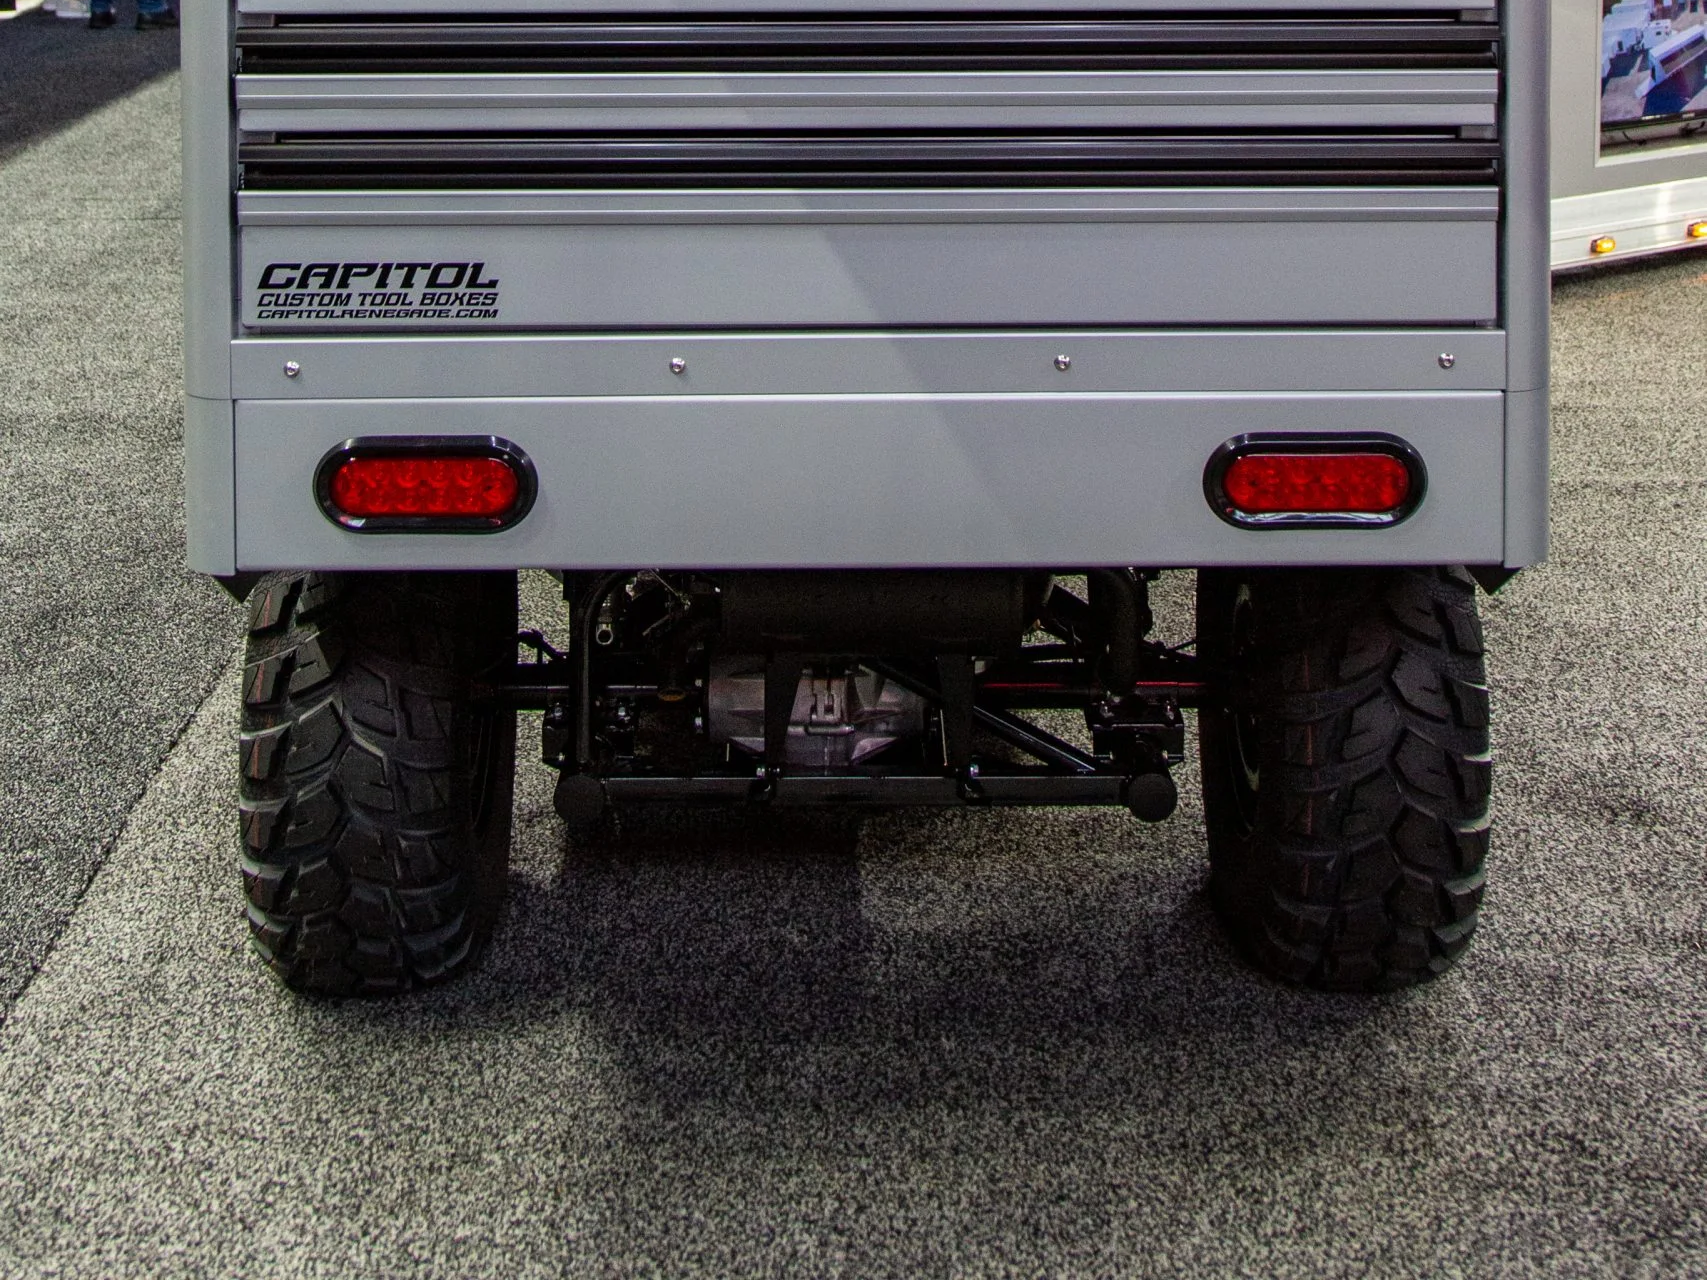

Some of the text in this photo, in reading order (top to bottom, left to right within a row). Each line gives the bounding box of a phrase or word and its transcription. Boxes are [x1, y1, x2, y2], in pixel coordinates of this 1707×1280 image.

[257, 263, 499, 289] CAPITOL
[257, 292, 499, 307] CUSTOM TOOL BOXES
[257, 309, 499, 319] CAPITOLRENEGADE.COM
